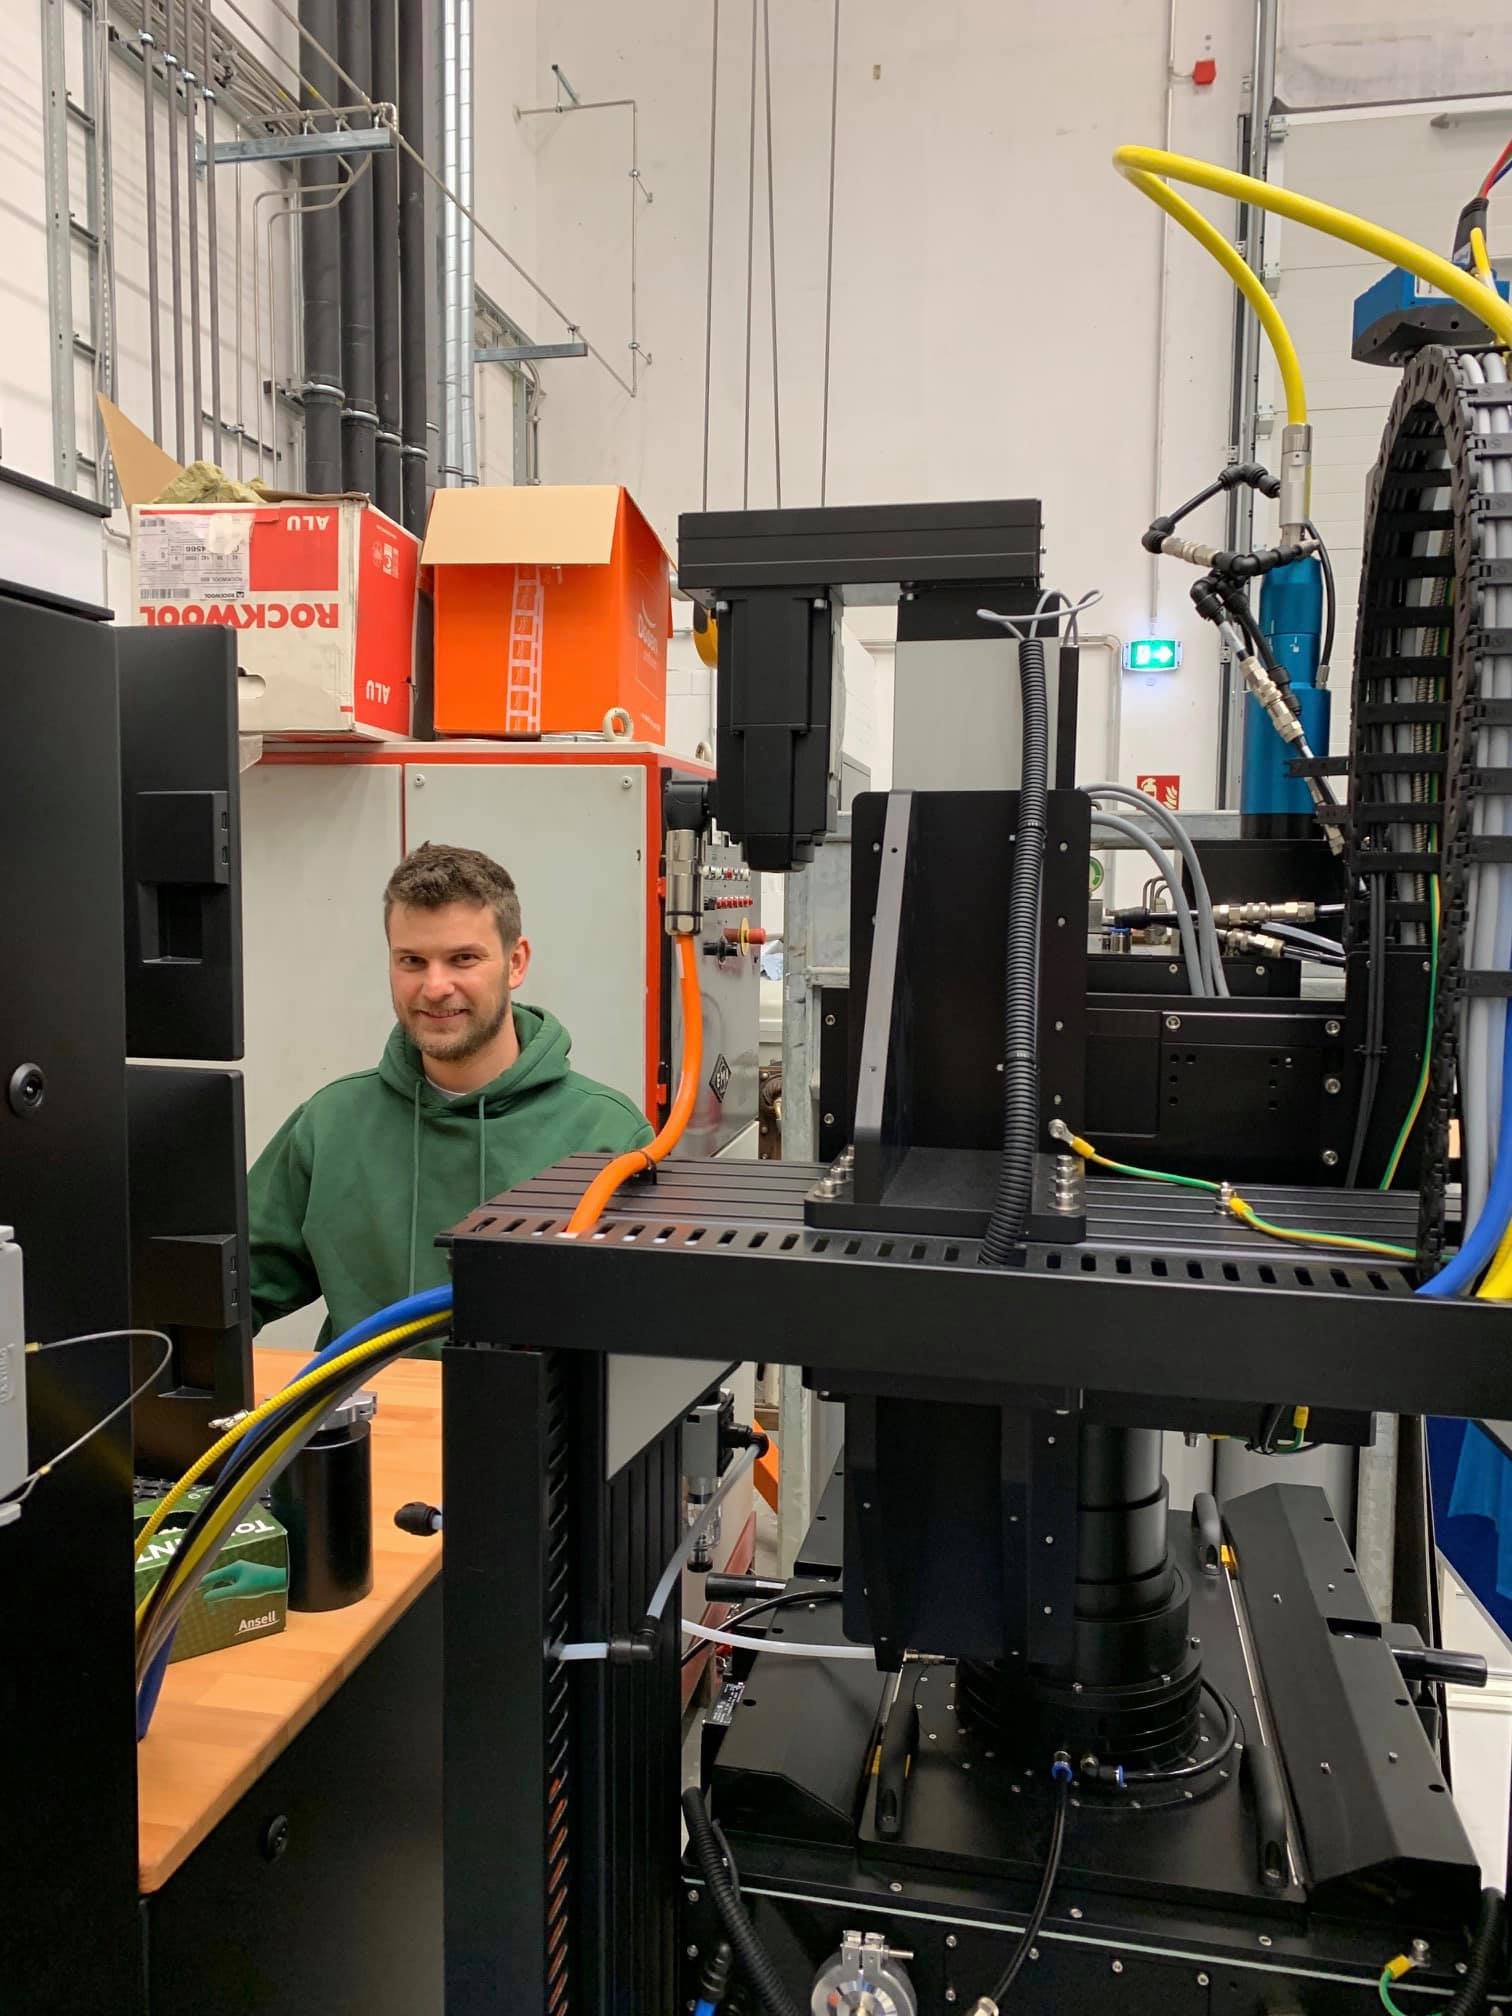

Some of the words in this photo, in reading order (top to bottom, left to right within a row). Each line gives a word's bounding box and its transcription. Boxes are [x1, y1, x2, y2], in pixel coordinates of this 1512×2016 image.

[286, 514, 330, 531] ALU
[203, 592, 236, 600] ROCKWOOL
[139, 603, 339, 629] ROCKWOOL
[365, 679, 391, 705] ALU
[238, 1609, 277, 1632] Ansell
